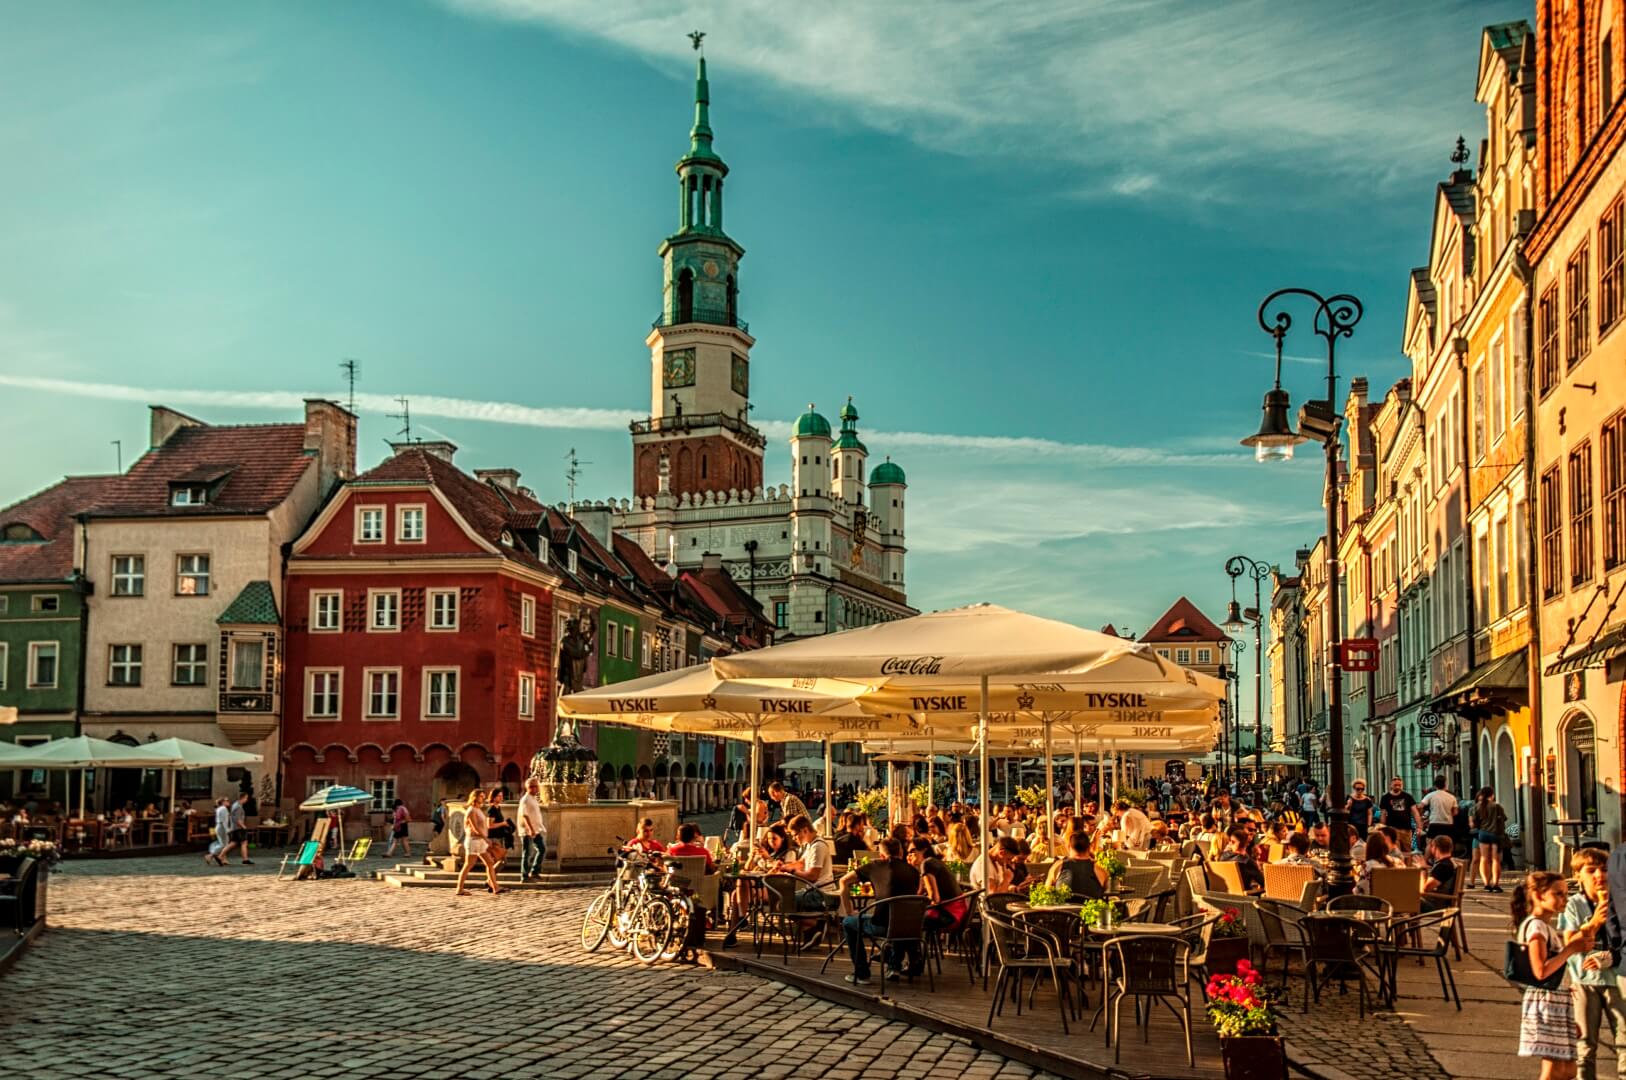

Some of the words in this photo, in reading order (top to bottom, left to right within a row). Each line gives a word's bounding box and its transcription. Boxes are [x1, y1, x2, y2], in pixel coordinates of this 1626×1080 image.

[608, 698, 659, 712] TYSKIE
[760, 699, 813, 713] TYSKIE
[910, 695, 968, 710] TYSKIE
[1085, 692, 1148, 708] TYSKIE
[1420, 714, 1437, 726] 48
